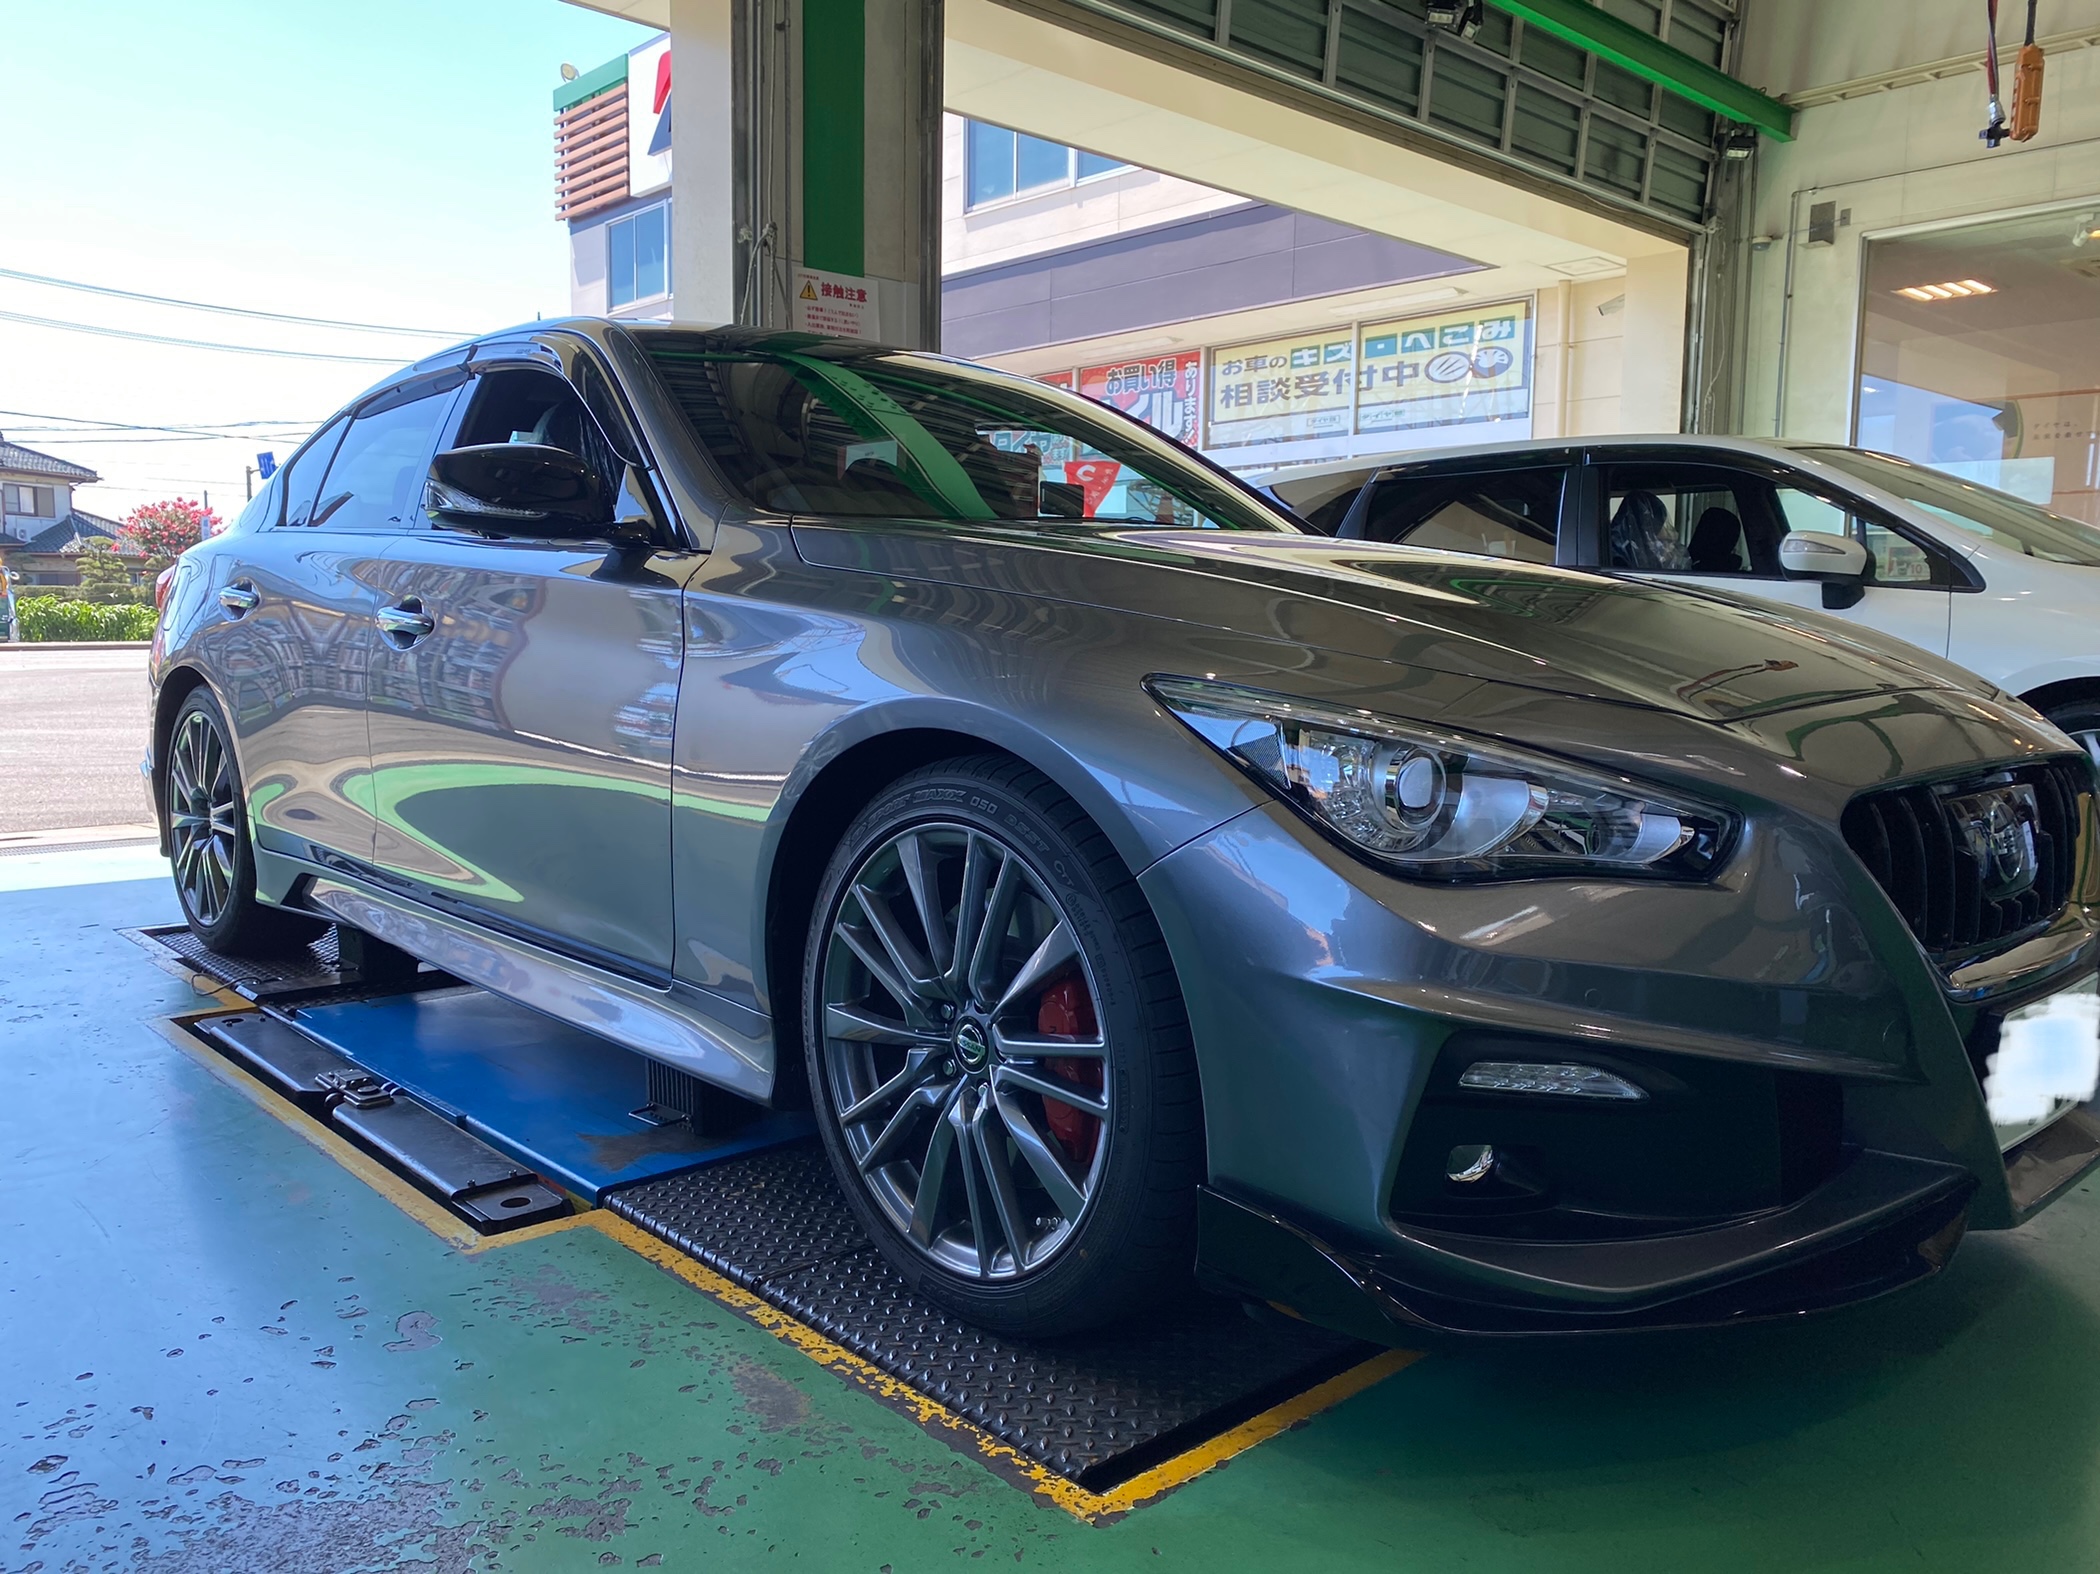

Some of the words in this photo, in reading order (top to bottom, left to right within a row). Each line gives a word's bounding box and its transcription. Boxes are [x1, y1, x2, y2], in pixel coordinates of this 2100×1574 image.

[821, 281, 868, 303] 接触注意
[1105, 358, 1177, 396] お買い得
[1220, 361, 1420, 409] 相談受付中
[913, 787, 967, 804] MAXX
[969, 796, 999, 815] 050
[1004, 814, 1050, 853] DSST
